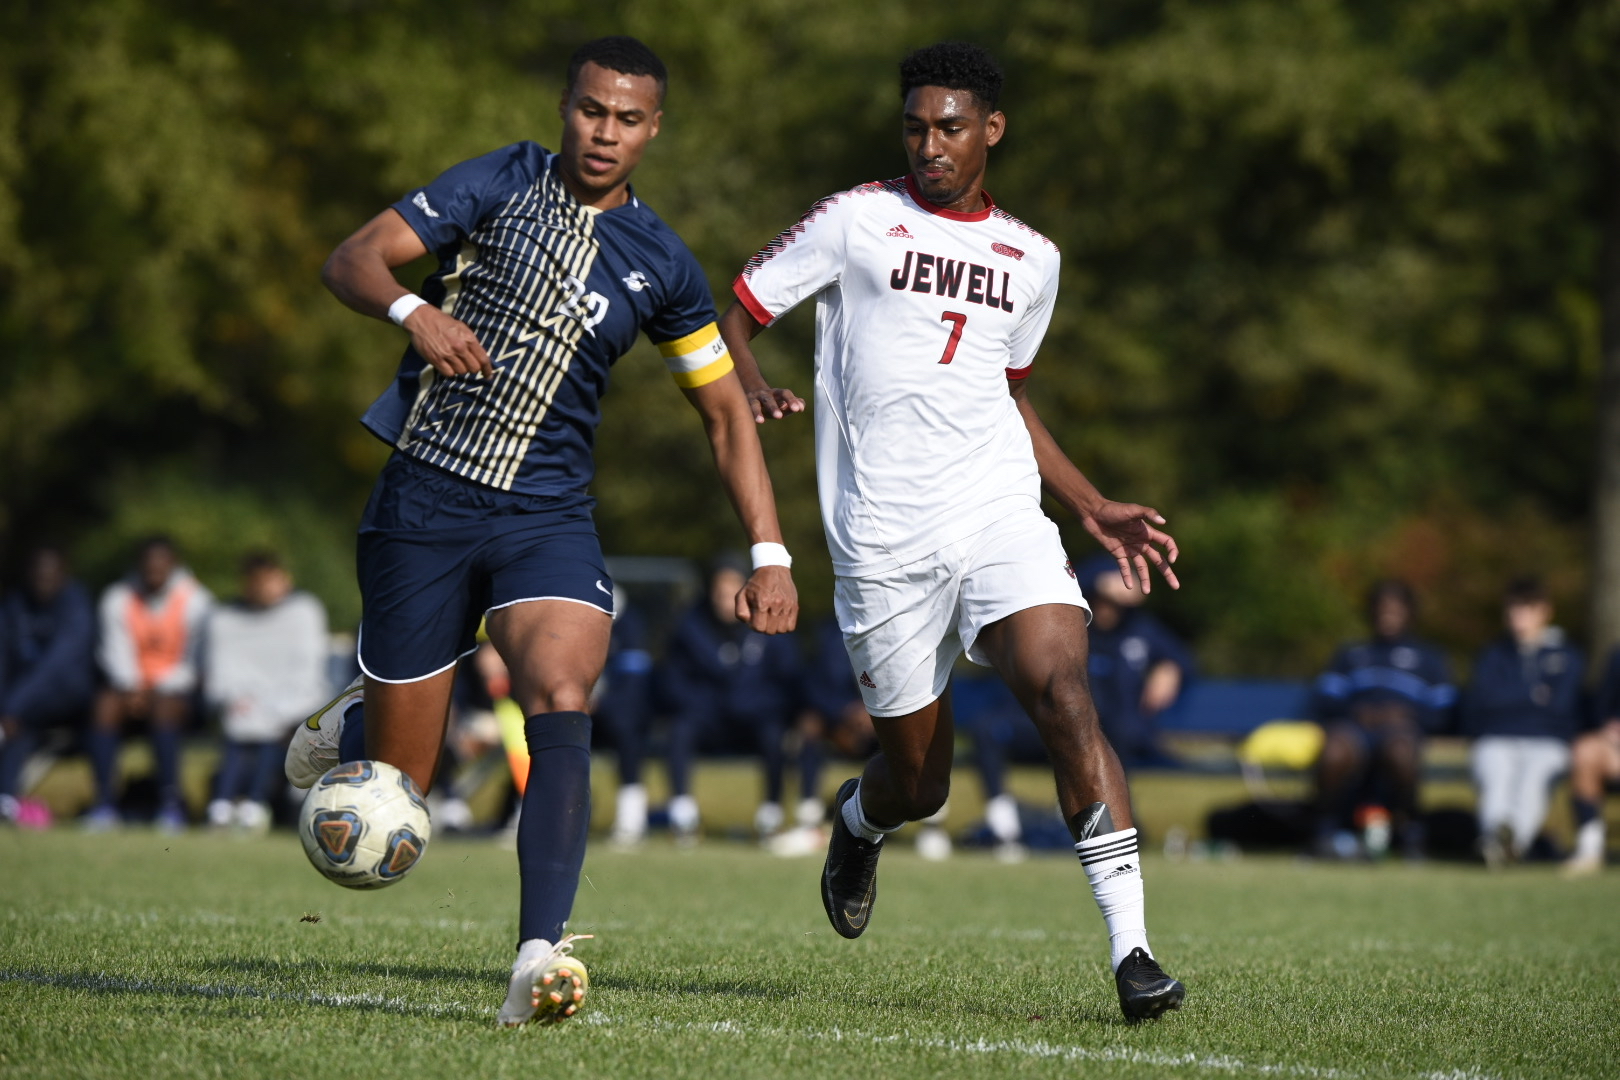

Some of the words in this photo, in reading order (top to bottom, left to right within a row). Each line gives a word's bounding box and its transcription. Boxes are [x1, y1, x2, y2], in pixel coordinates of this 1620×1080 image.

[886, 231, 914, 240] adidas
[890, 251, 1014, 313] JEWELL
[938, 310, 968, 365] 7
[1104, 868, 1138, 880] adidas
